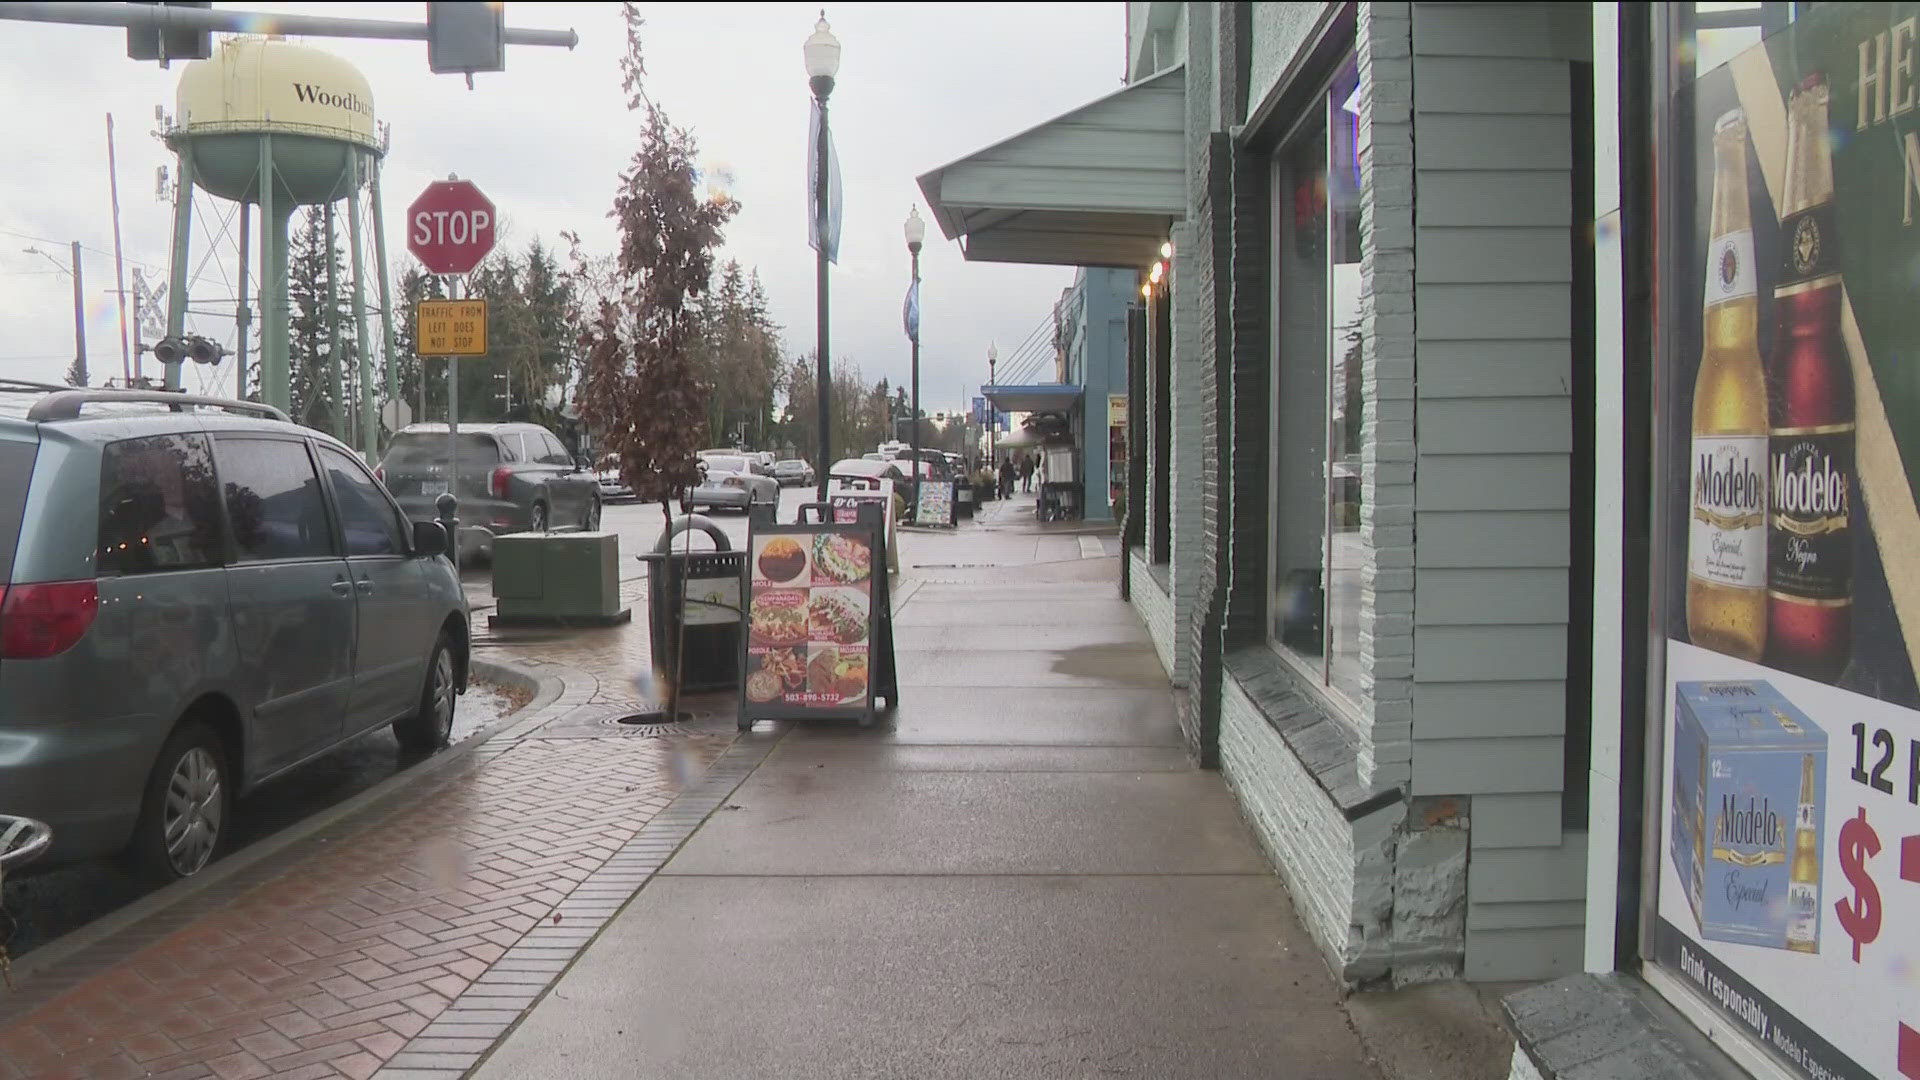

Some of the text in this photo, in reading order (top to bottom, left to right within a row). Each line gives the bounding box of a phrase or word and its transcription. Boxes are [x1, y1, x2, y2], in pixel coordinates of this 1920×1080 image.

[1857, 17, 1920, 132] HE
[414, 211, 489, 246] STOP
[421, 306, 482, 318] TRAFFIC FROM
[428, 322, 475, 333] LEFT DOES
[430, 337, 473, 348] NOT STOP
[1700, 453, 1757, 508] Modelo
[1771, 453, 1841, 513] Modelo
[1711, 758, 1723, 778] 12
[1851, 722, 1895, 795] 12
[1721, 794, 1777, 846] Modelo
[1723, 869, 1769, 911] Especial
[1680, 945, 1705, 987] Drink
[1707, 971, 1770, 1039] responsibly.
[1773, 1025, 1801, 1063] Modelo
